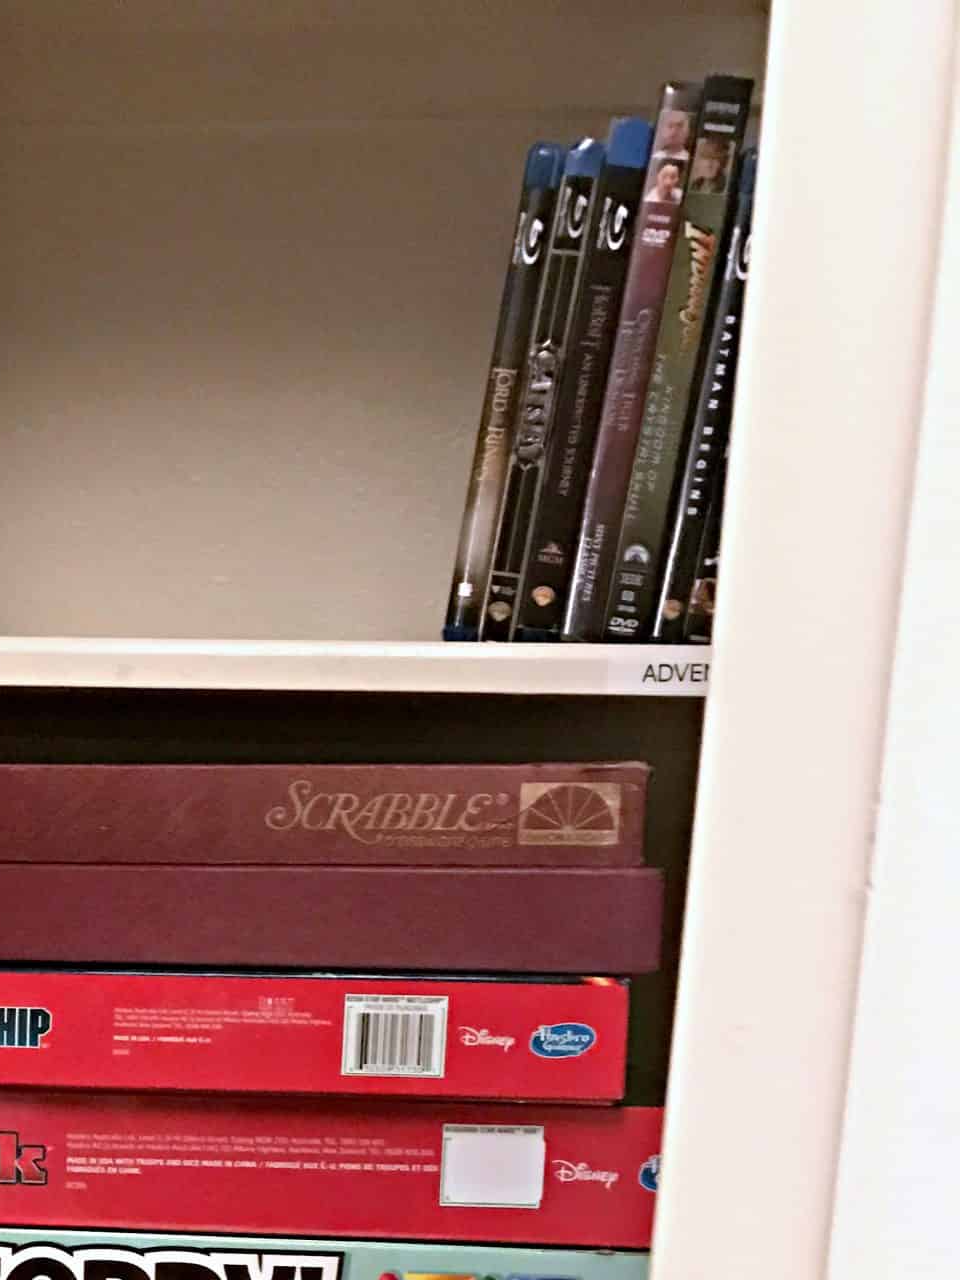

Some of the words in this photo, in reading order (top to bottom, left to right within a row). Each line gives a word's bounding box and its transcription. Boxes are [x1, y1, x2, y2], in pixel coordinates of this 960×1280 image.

[707, 313, 736, 411] BATMAN
[685, 424, 713, 517] BEGINS
[457, 1025, 516, 1053] Disney
[551, 1159, 619, 1189] Disney
